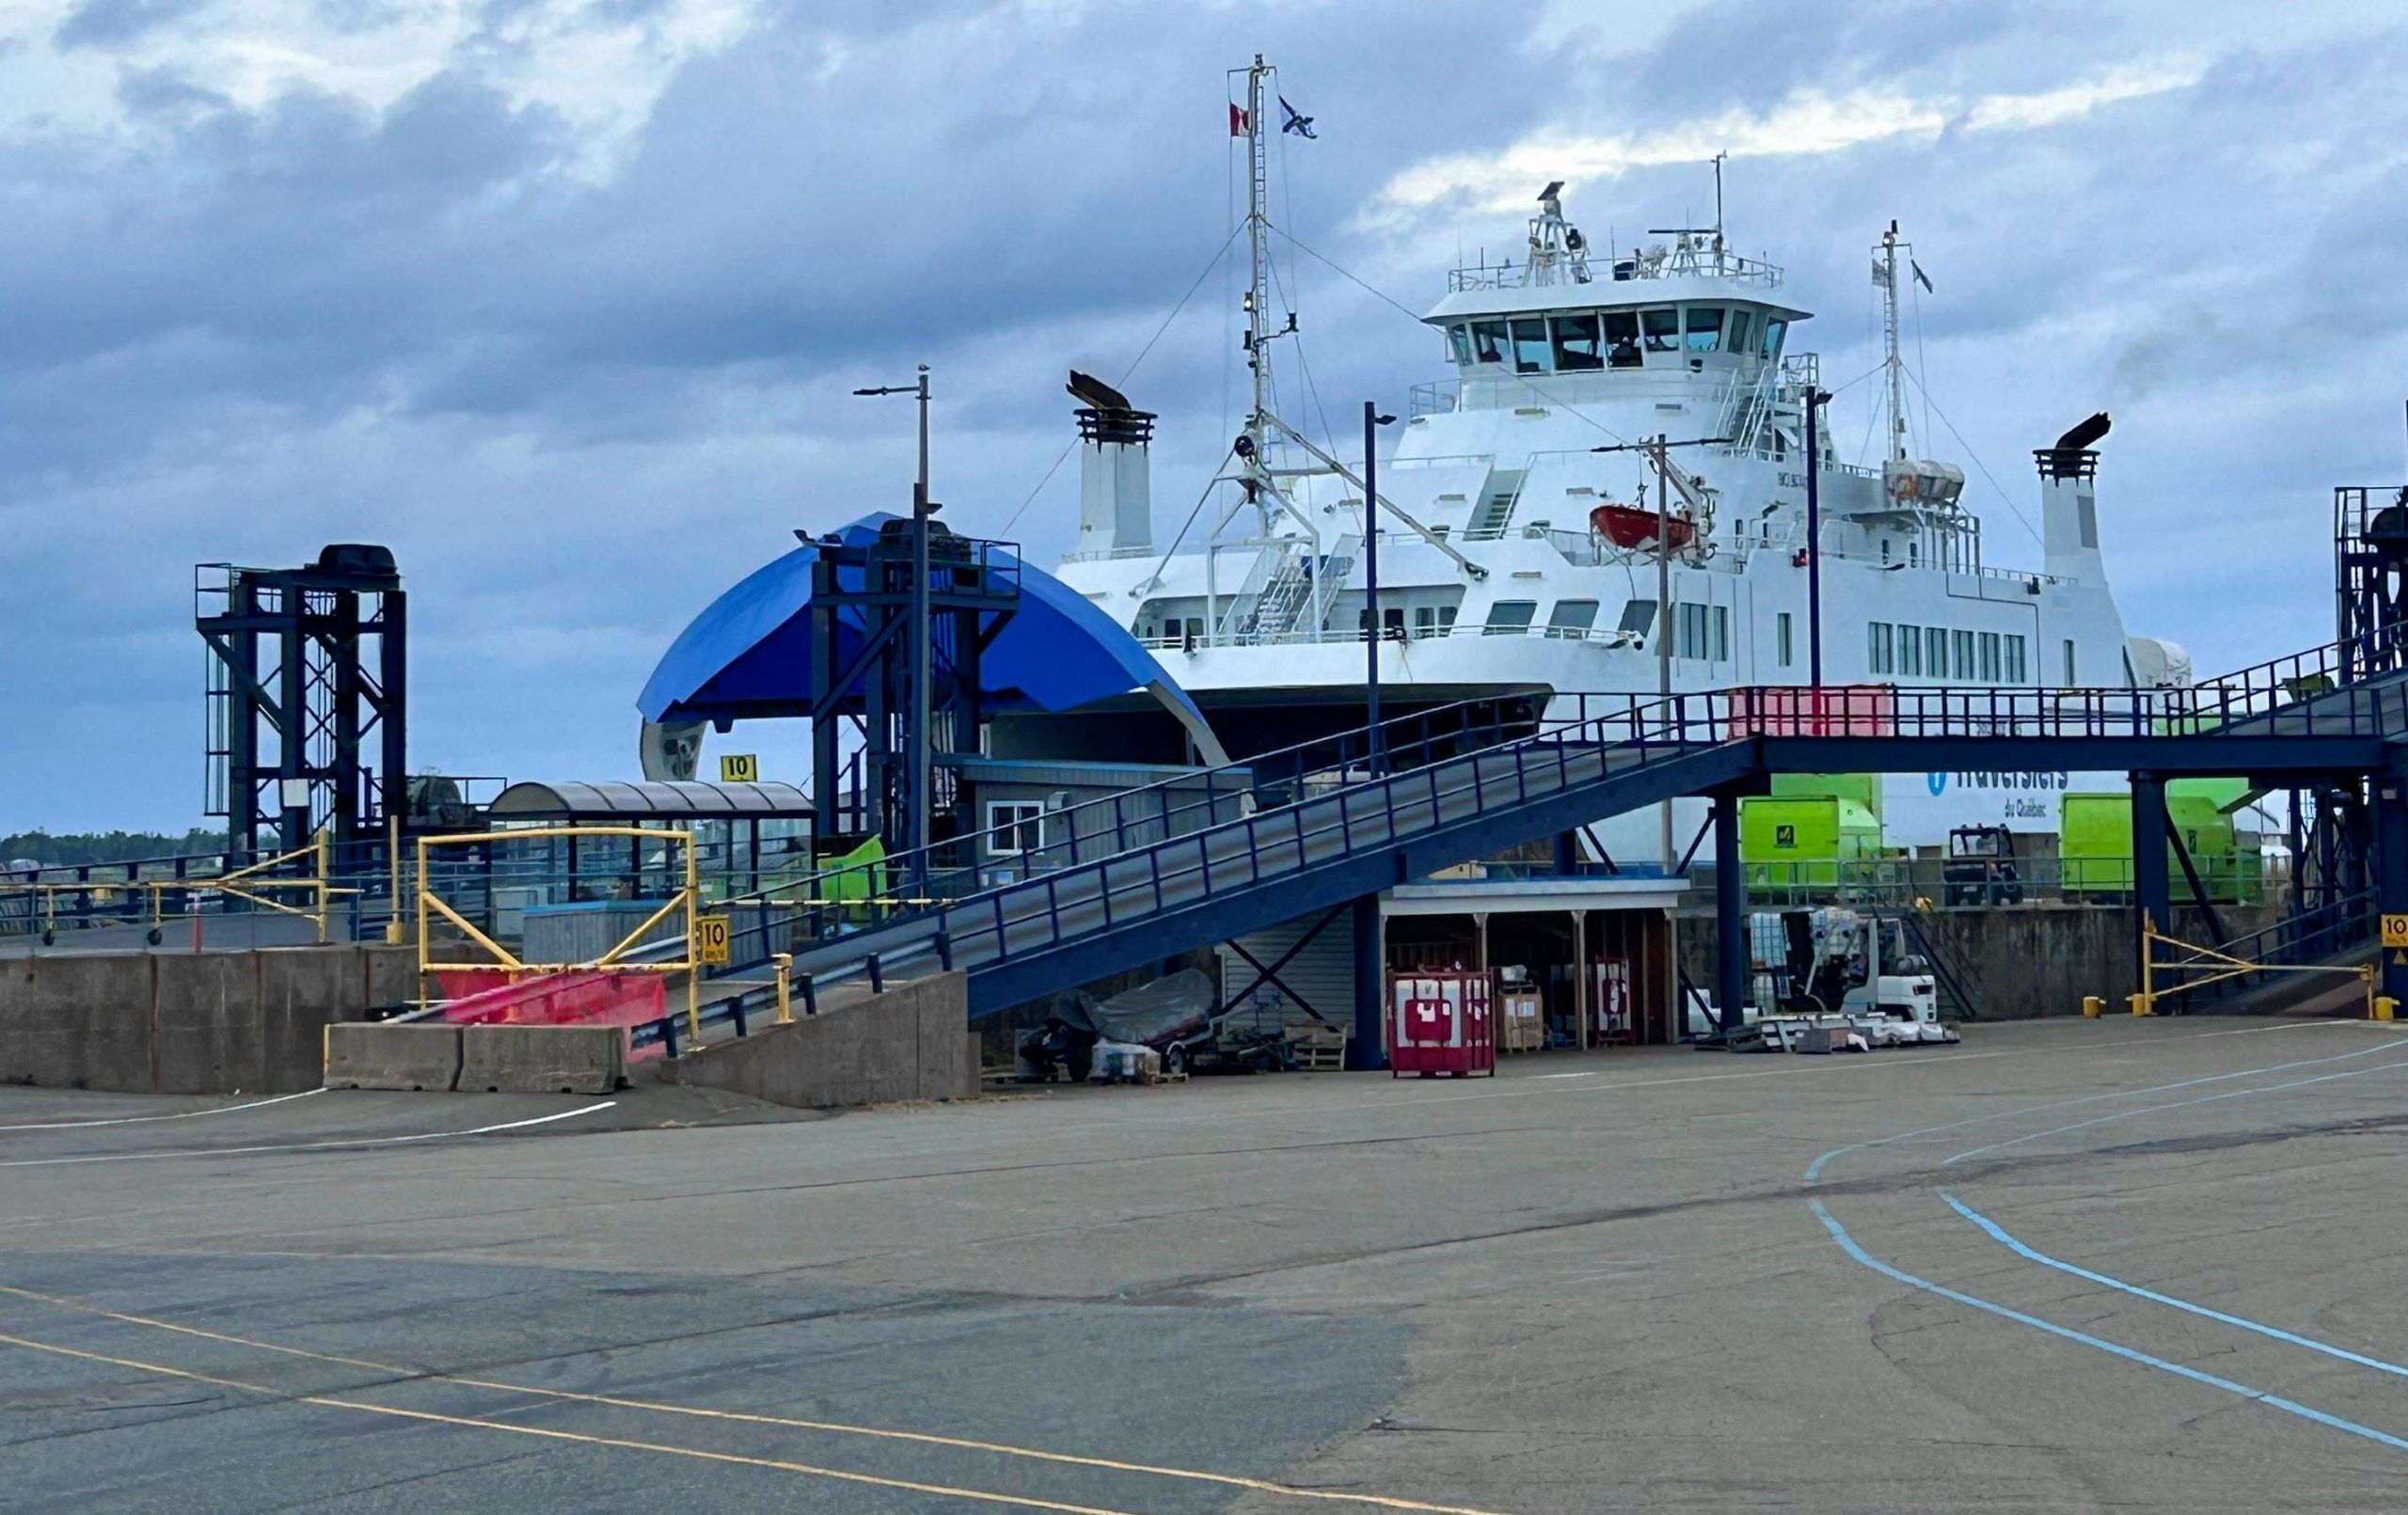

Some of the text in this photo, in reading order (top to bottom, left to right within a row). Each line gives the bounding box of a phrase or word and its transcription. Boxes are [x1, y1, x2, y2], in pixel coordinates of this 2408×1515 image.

[729, 756, 748, 776] 10
[705, 923, 724, 946] 10
[2385, 918, 2407, 935] 10
